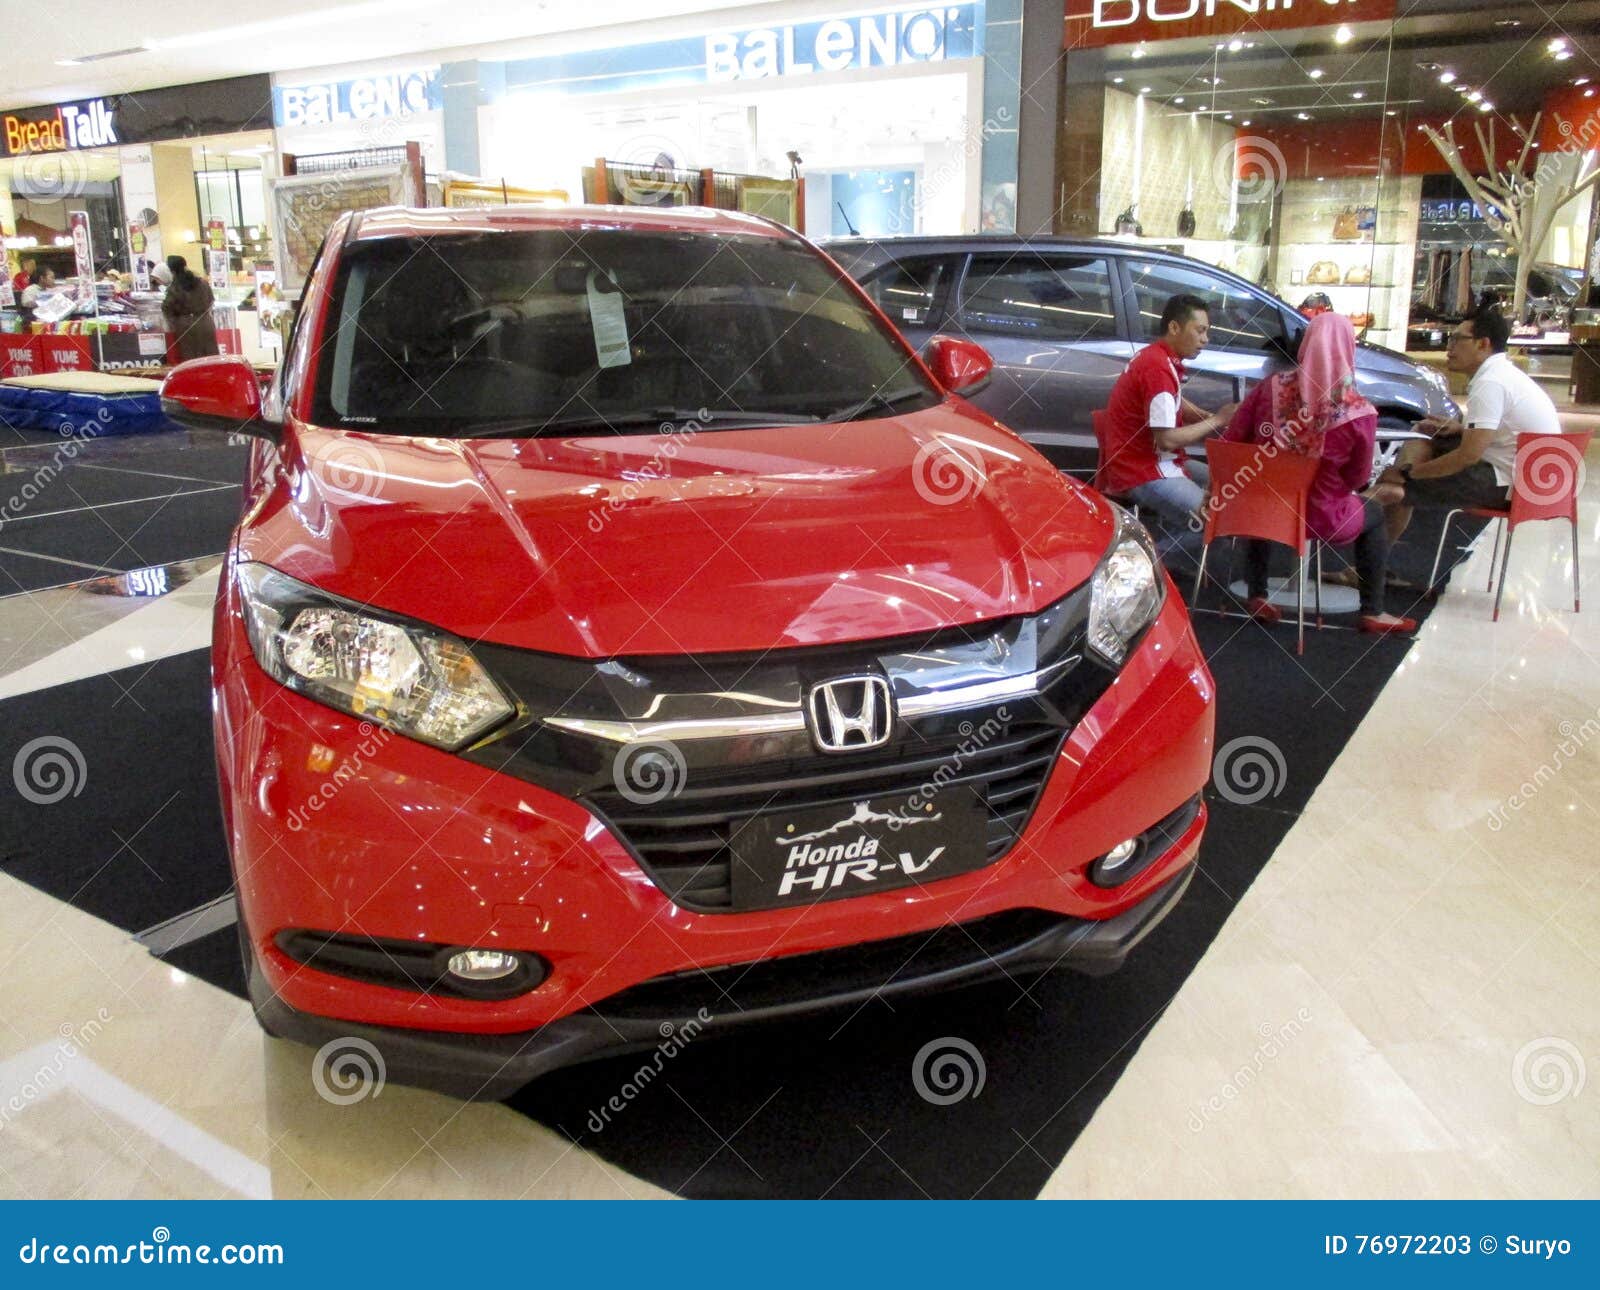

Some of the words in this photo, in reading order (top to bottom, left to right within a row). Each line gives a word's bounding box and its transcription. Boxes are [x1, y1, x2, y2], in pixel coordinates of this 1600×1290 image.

[1092, 0, 1358, 28] DON
[5, 99, 118, 154] BreadTalk
[8, 347, 33, 362] YUME
[52, 349, 79, 364] YUME
[785, 836, 880, 869] Honda
[778, 846, 946, 896] HR-V
